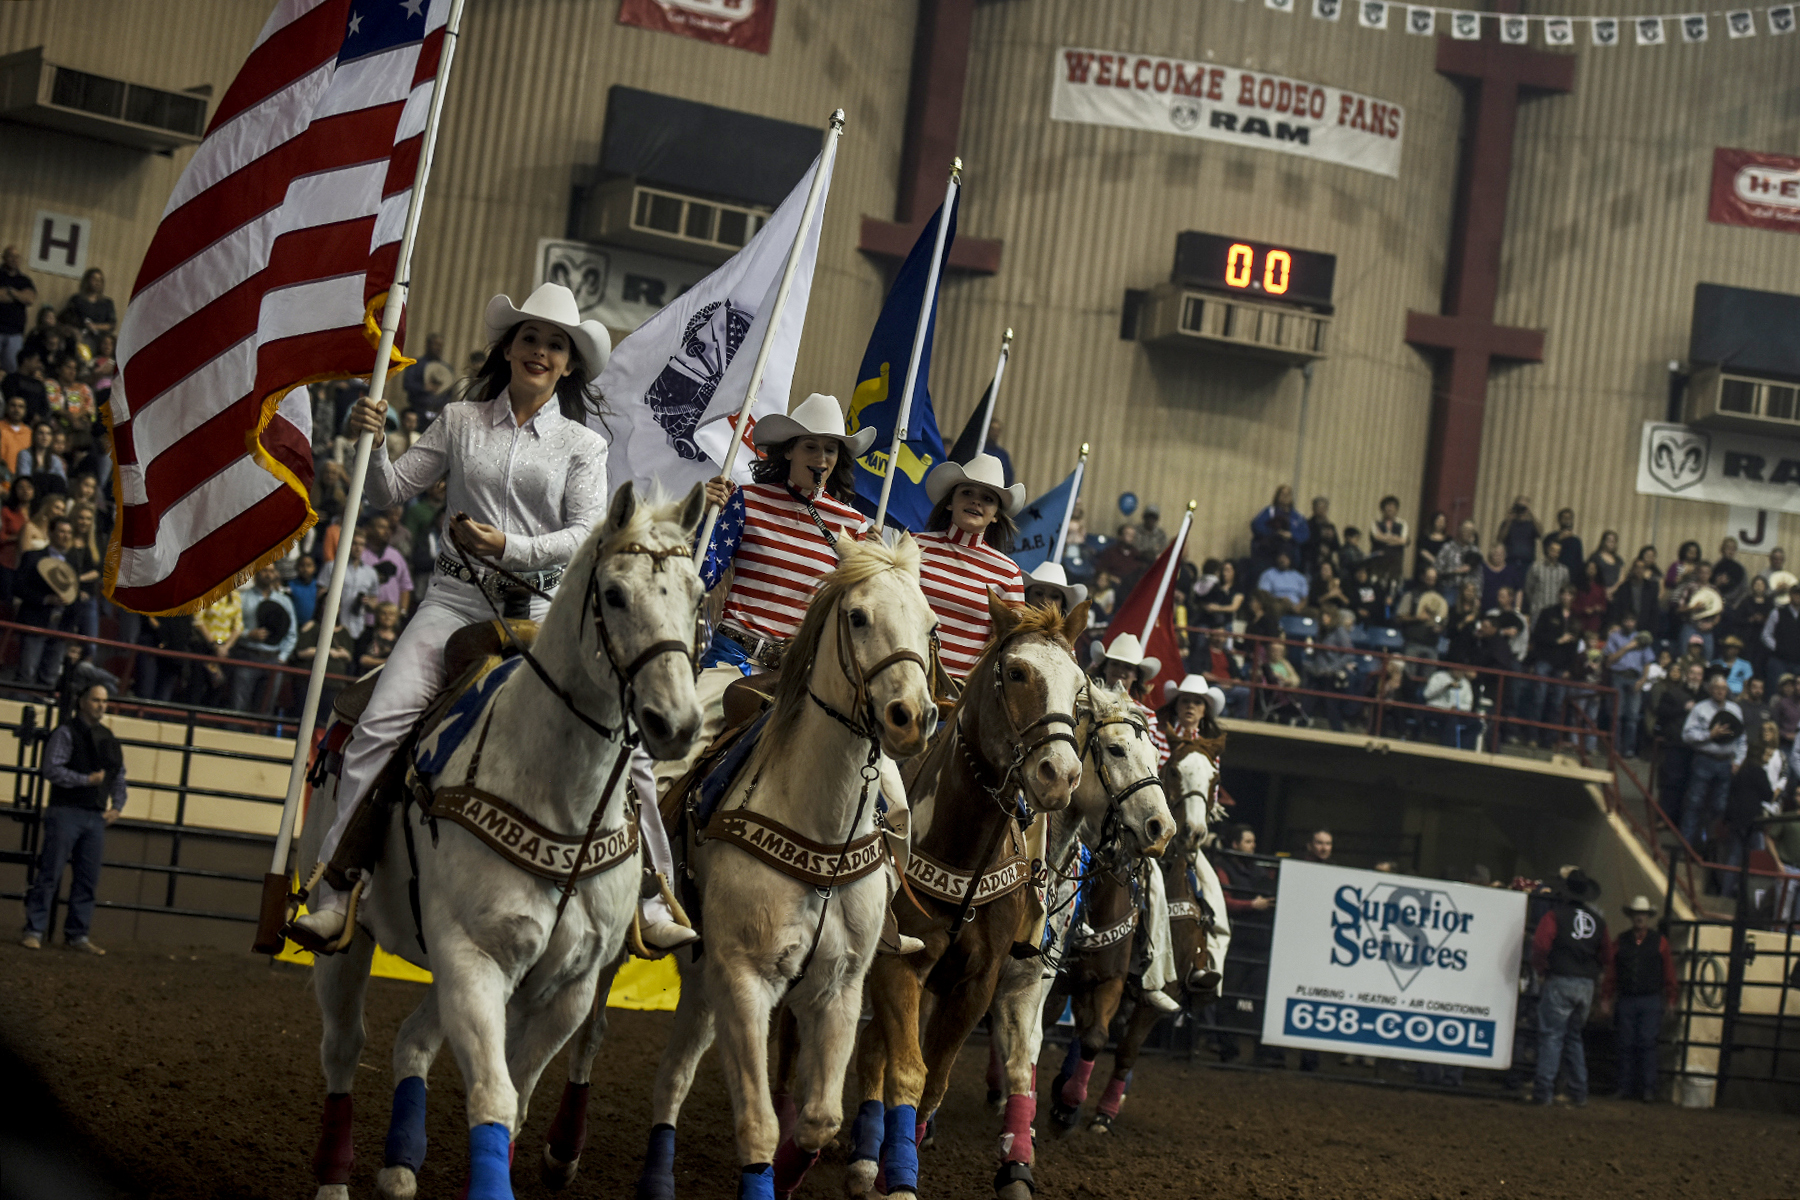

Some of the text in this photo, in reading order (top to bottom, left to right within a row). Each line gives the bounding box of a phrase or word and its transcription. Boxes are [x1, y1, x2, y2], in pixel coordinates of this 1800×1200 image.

[1065, 51, 1401, 139] WELCOME RODEO FANS
[1210, 110, 1310, 146] RAM
[39, 218, 80, 267] H
[1225, 243, 1291, 295] 0.0
[1723, 451, 1800, 485] RA
[1739, 509, 1767, 547] J
[463, 801, 627, 869] AMBASSADOR
[750, 828, 876, 875] AMBASSADOR
[1330, 885, 1474, 934] Superior
[1330, 922, 1468, 972] Services
[1296, 985, 1491, 1017] PLUMBING HEATING AIR CONDITIONING
[1291, 1003, 1490, 1049] 658-COOL
